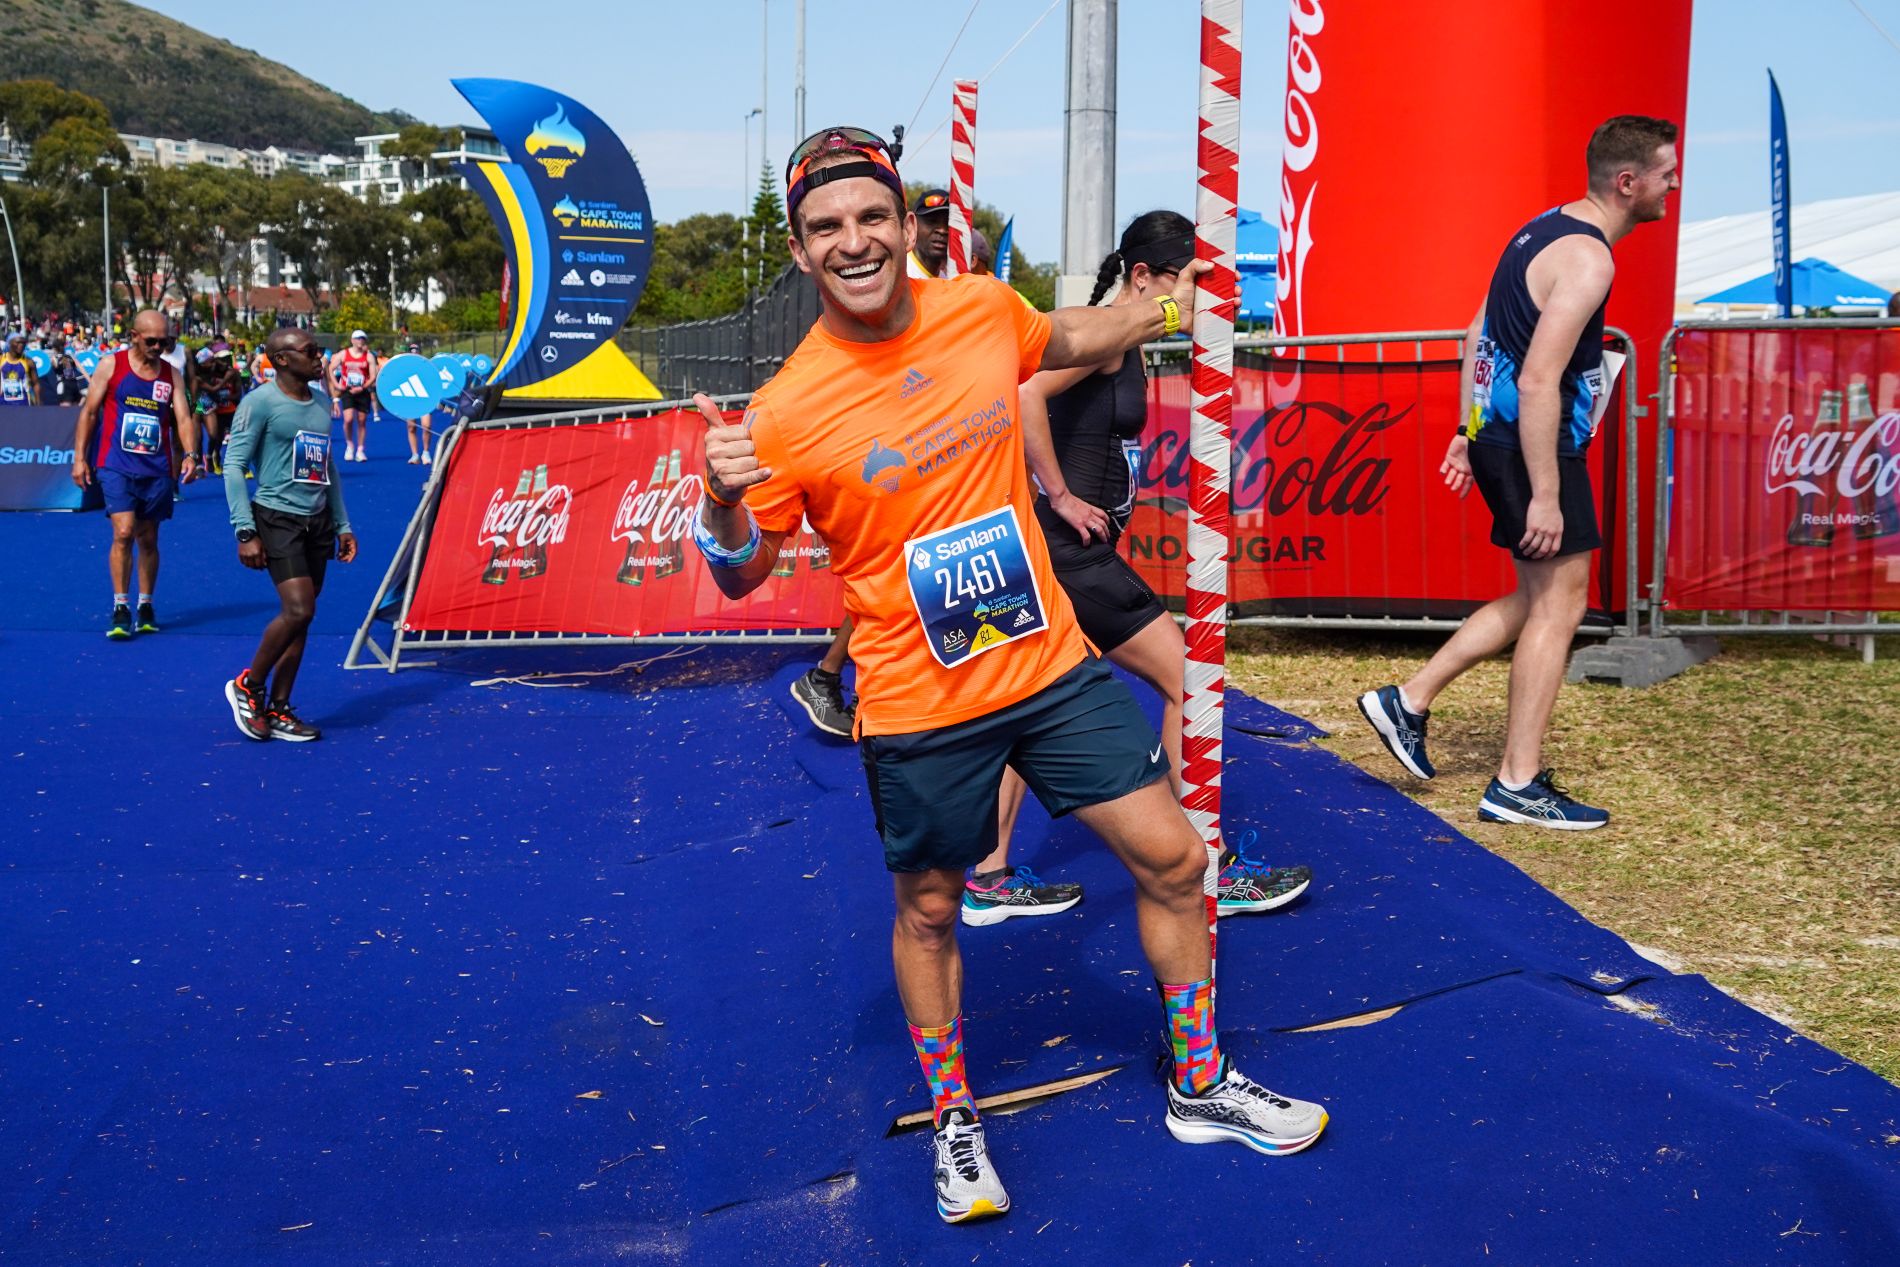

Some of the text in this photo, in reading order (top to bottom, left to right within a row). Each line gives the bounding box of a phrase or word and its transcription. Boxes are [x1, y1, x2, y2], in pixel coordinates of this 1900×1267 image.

[580, 208, 642, 220] CAPE TOWN
[580, 218, 642, 230] MARATHON
[576, 251, 625, 264] Sanlam
[586, 312, 609, 325] kfm
[899, 377, 934, 399] adidas
[134, 423, 152, 439] 471
[911, 426, 959, 460] CAPE
[960, 396, 1007, 432] TOWN
[915, 415, 951, 438] Sanlam
[303, 443, 322, 462] 1416
[917, 413, 1012, 477] MARATHON
[1765, 411, 1900, 499] Coca-Co
[611, 473, 706, 544] Coca-Col
[1802, 512, 1881, 526] Real Magic
[935, 523, 1008, 561] Sanlam
[1130, 534, 1183, 563] NO
[1228, 535, 1326, 563] UGAR
[627, 555, 673, 567] Real Magic
[798, 545, 830, 559] Magic
[492, 557, 537, 569] Real Magic
[934, 549, 1007, 609] 2461
[990, 592, 1027, 611] CAPE TOWN
[991, 598, 1029, 618] MARATHON
[993, 593, 1012, 604] Sanlam
[1013, 615, 1035, 628] adidas
[943, 628, 966, 647] ASA
[980, 628, 993, 645] B1
